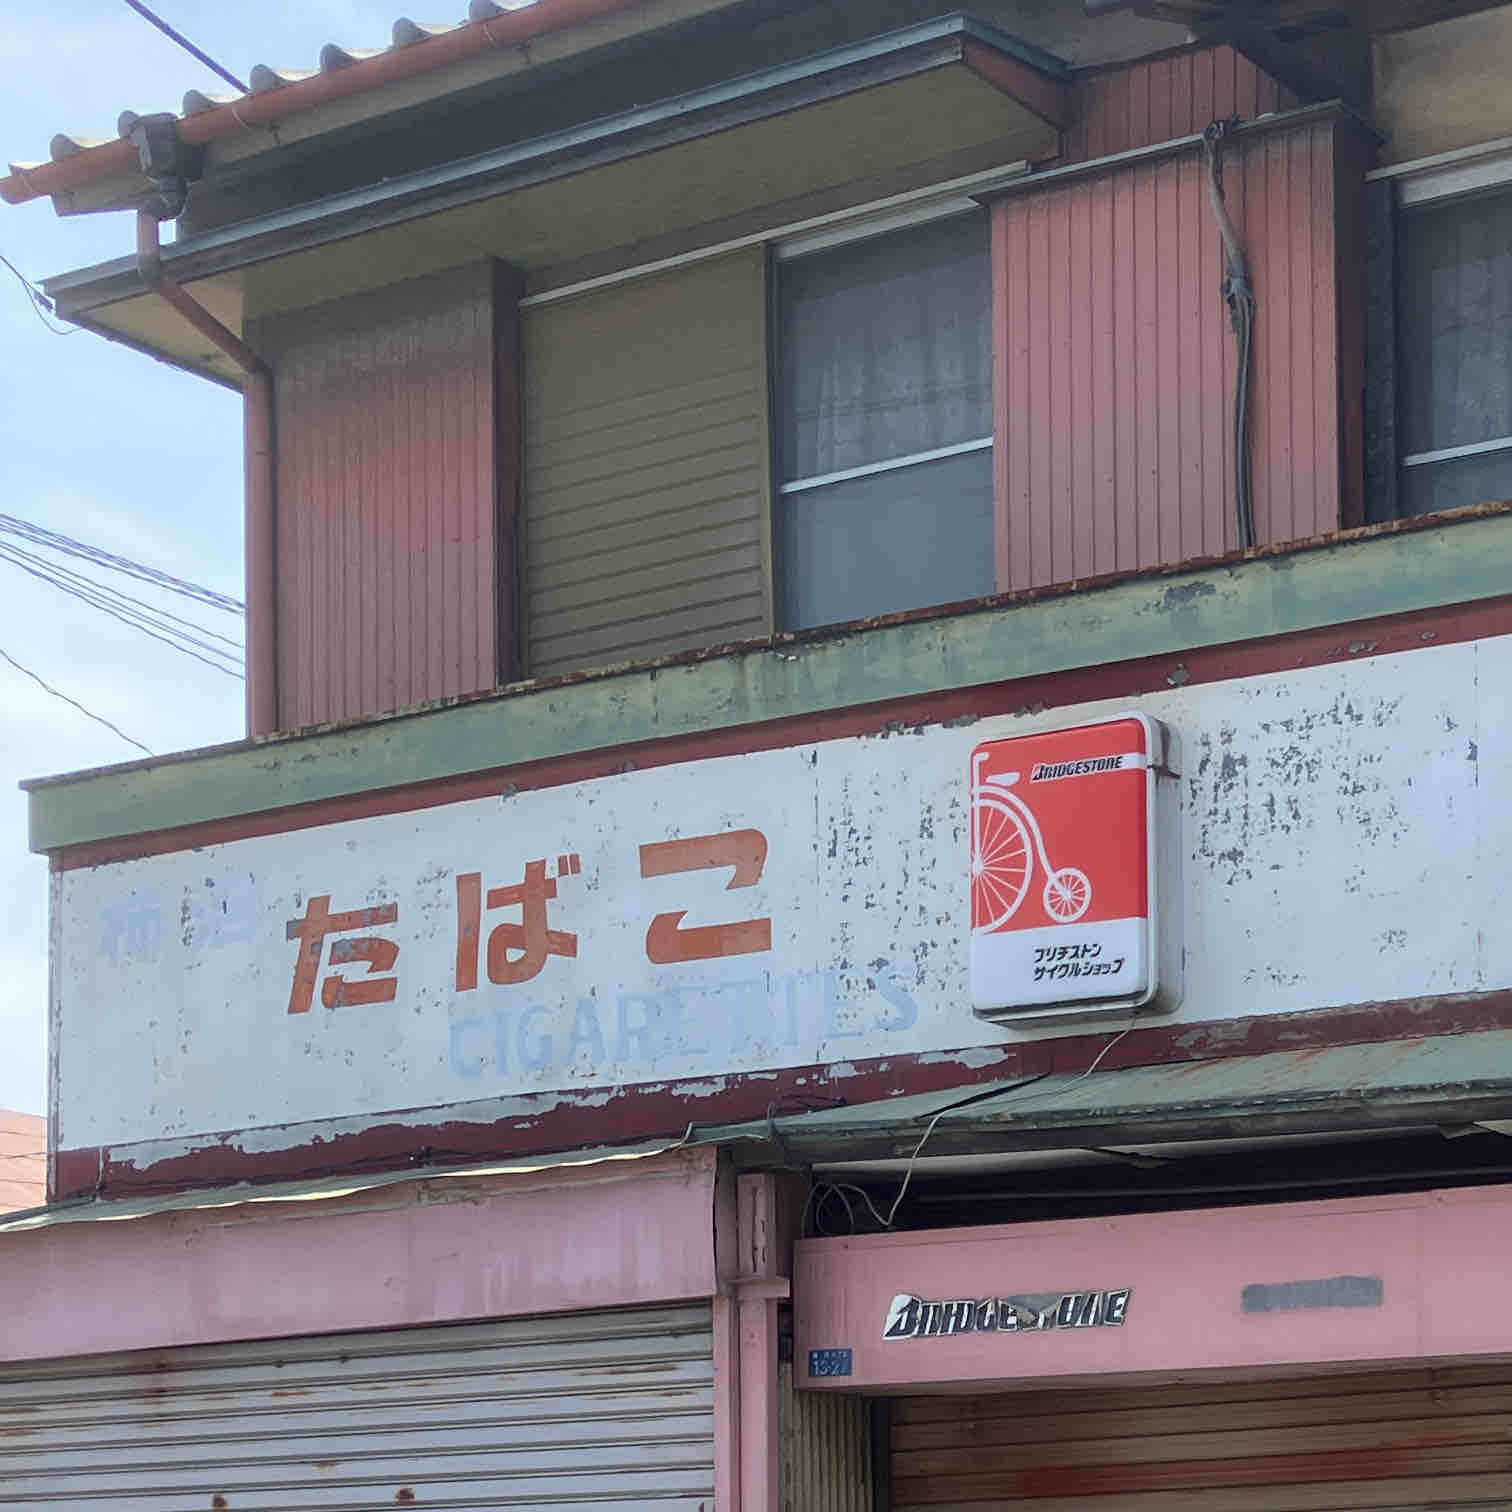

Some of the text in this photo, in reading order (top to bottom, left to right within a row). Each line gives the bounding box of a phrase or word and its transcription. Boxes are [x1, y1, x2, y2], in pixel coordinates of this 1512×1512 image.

[1032, 756, 1123, 781] BRIDGESTONE
[287, 829, 772, 1014] たばこ
[1034, 957, 1126, 982] サイクルショップ
